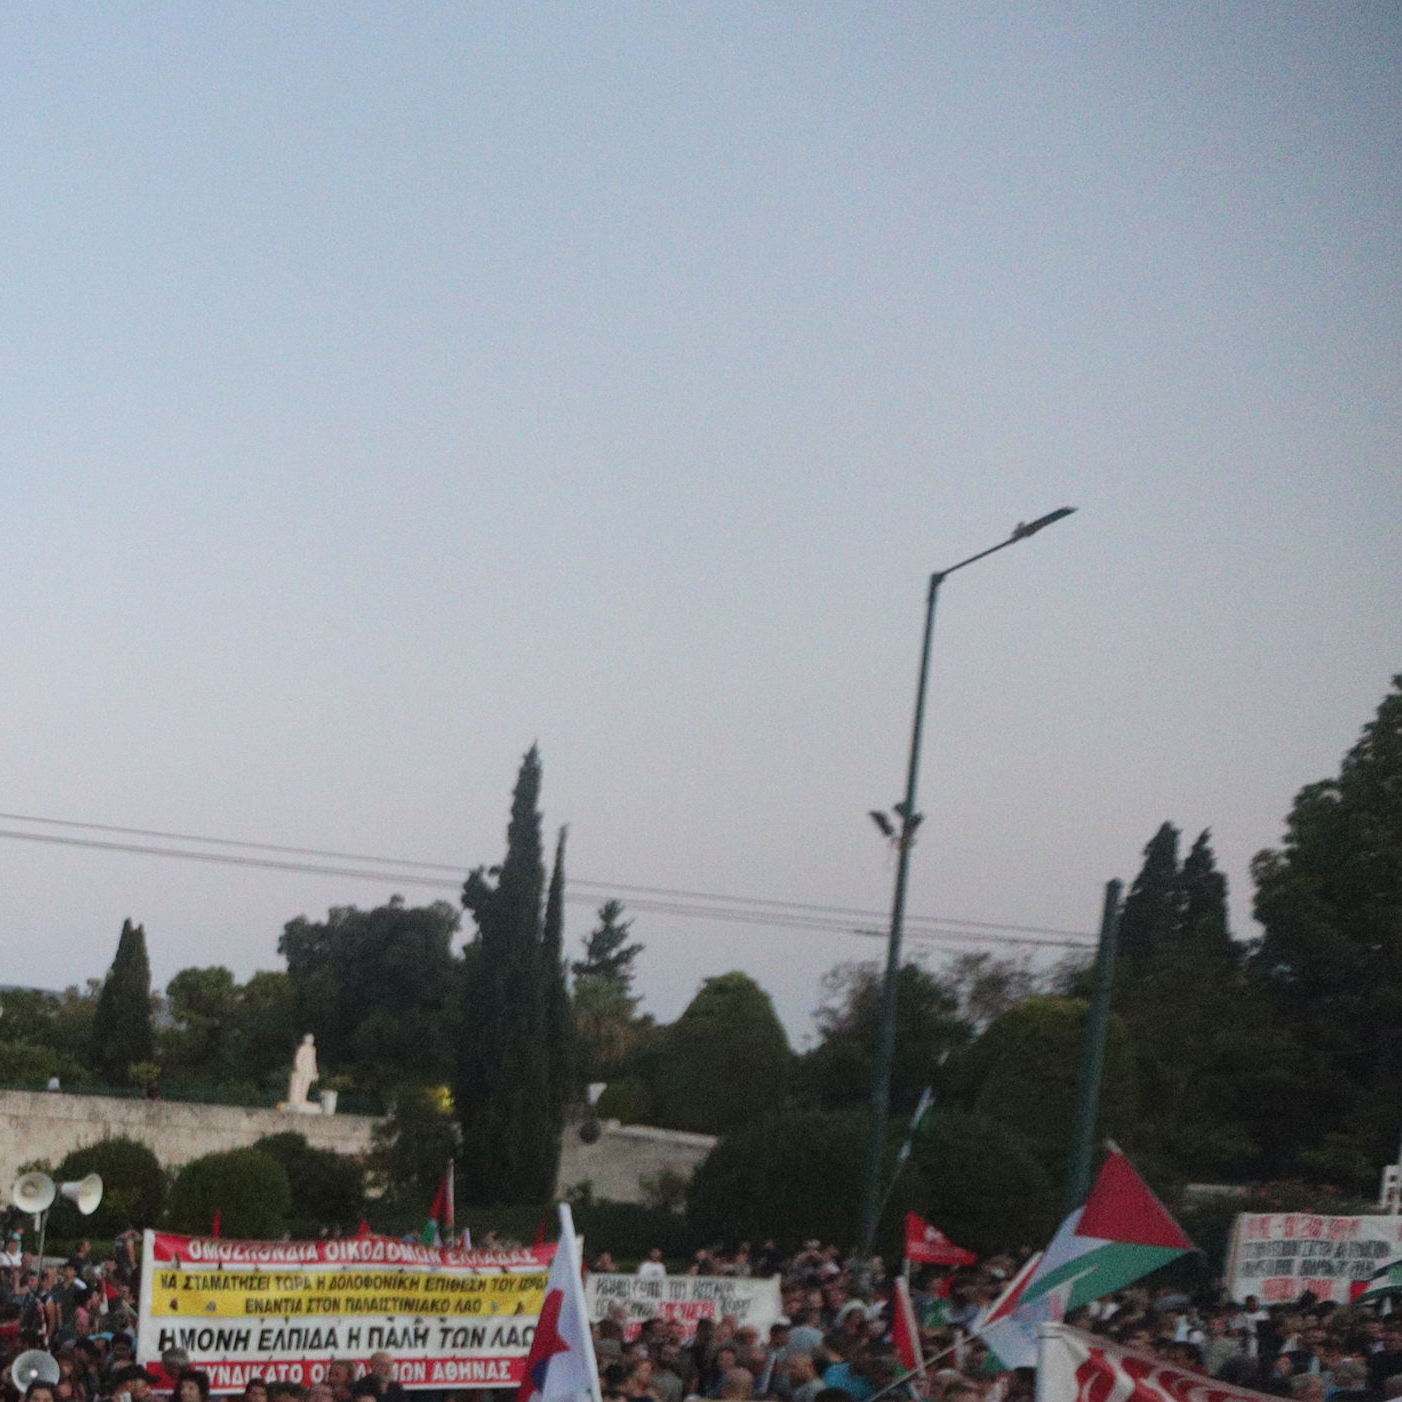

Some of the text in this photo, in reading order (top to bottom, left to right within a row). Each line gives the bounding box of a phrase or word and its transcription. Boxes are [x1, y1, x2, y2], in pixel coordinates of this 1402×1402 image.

[183, 1274, 271, 1291] ΣΤΑΜΑΤΗΣΕΙ
[275, 1275, 312, 1291] ΤΩΡΑ
[328, 1274, 420, 1291] ΔΟΛΟΦΟΝΙΚΗ
[425, 1275, 487, 1292] ΕΠΙΘΕΣΗ
[245, 1298, 482, 1314] ΕΝΑΝΤΙΑ ΣΤΟΝ ΠΑΛΑΙΣΤΙΝΙΑΚΟ ΛΑΟ
[180, 1328, 251, 1351] ΜΟΝΗ
[258, 1328, 339, 1351] ΕΛΠΙΔΑ
[347, 1327, 361, 1350] Η
[368, 1326, 429, 1350] ΠΑΛΗ
[439, 1327, 486, 1350] ΤΩΝ
[490, 1327, 536, 1350] ΛΑΩ
[198, 1363, 304, 1387] ΥΝΔΙΚΑΤΟ
[432, 1360, 512, 1381] ΑΘΗΝΑΣ
